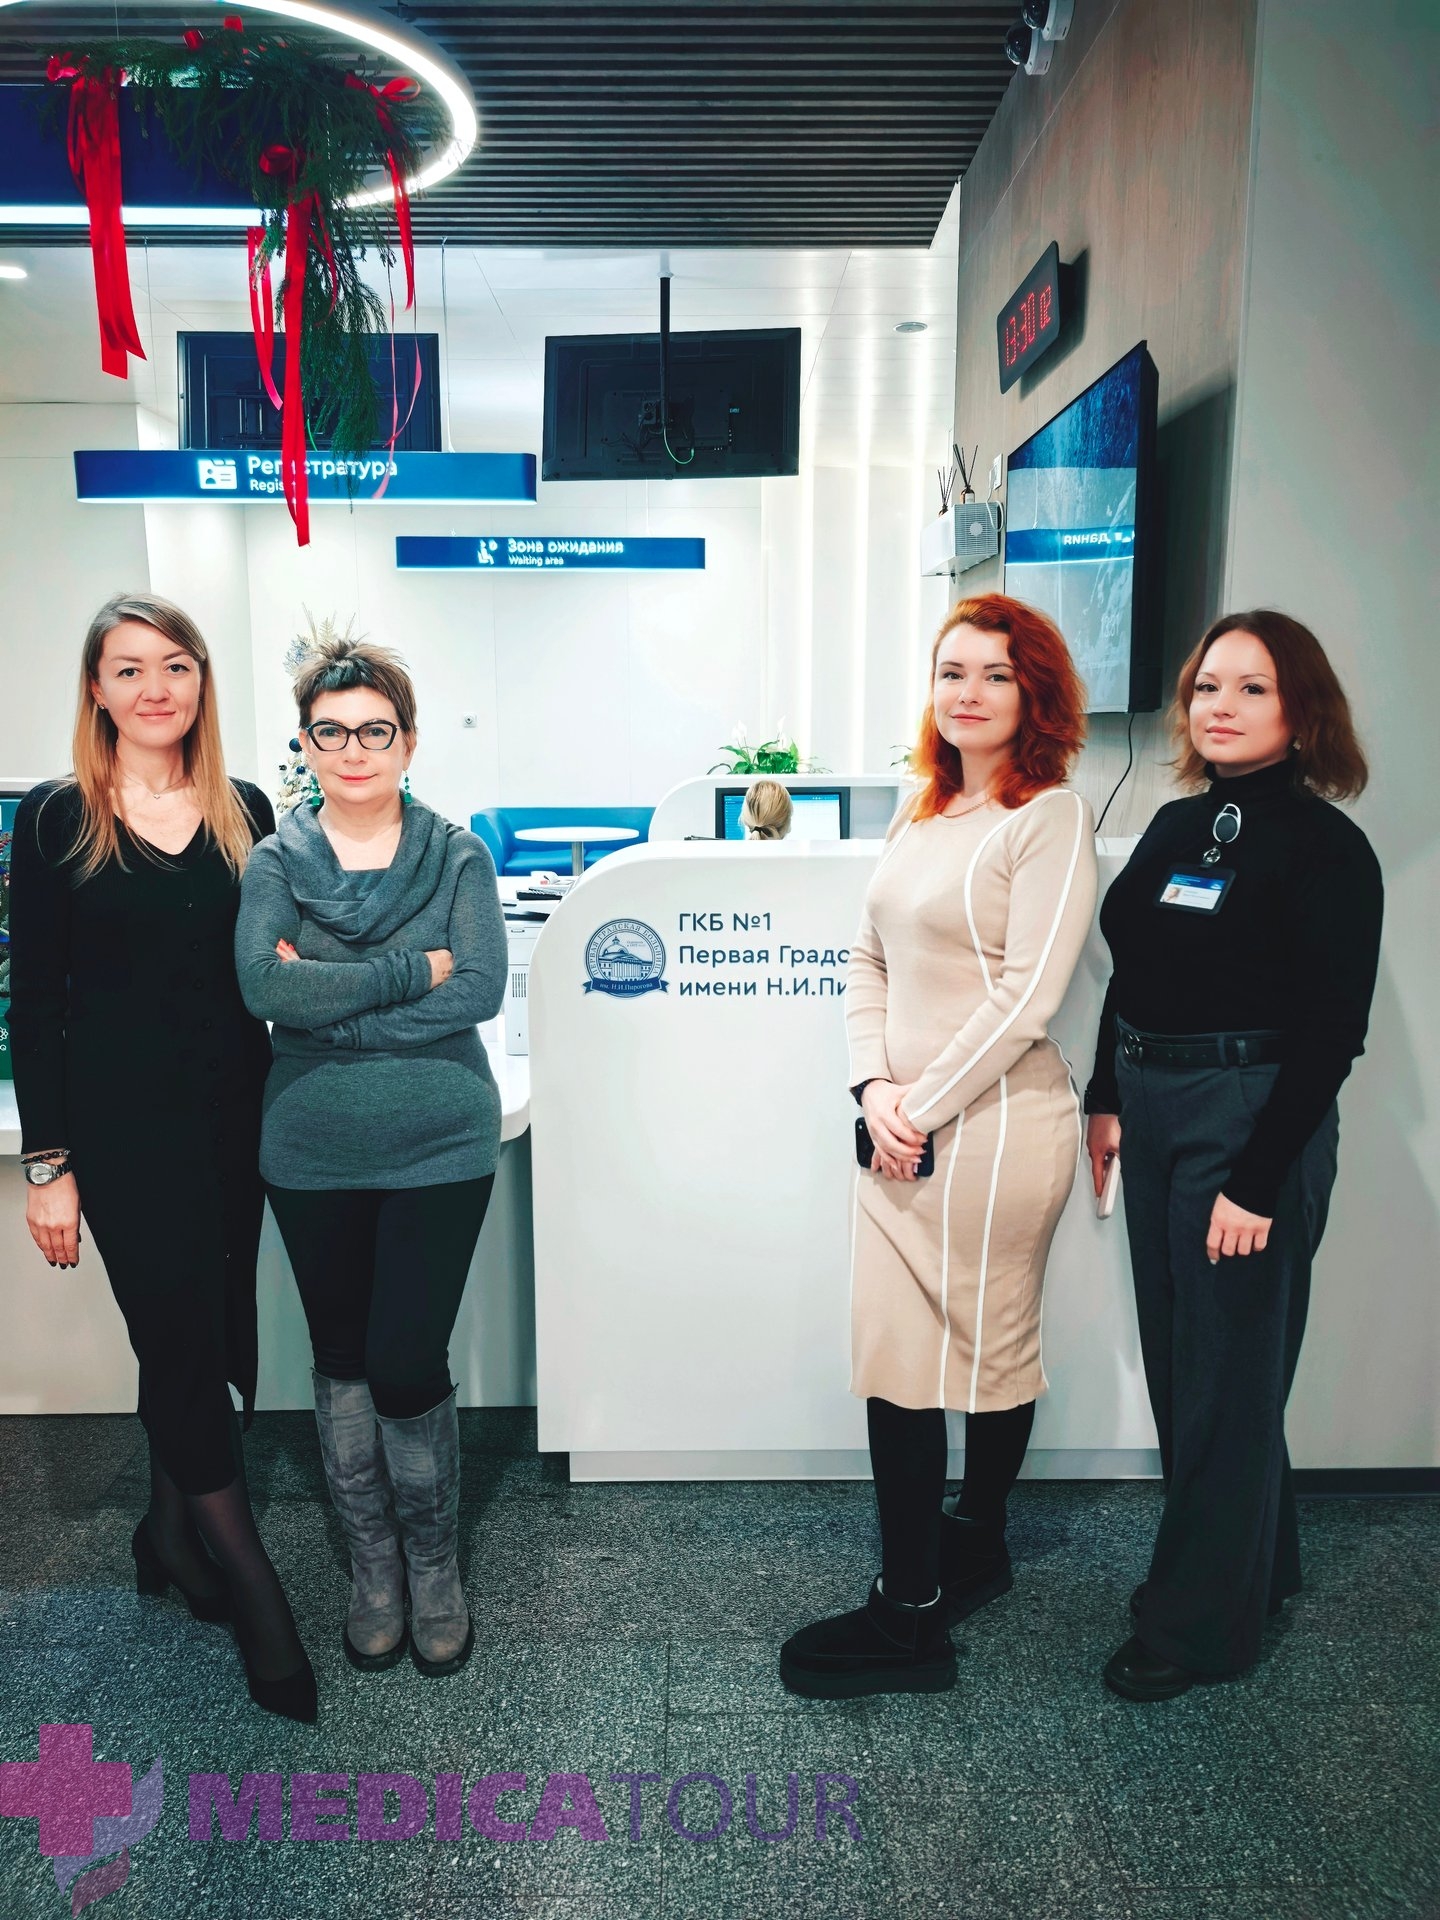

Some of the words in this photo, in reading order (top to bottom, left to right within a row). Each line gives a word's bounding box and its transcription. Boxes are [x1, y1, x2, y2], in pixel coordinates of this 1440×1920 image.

[1006, 291, 1036, 366] 13:30
[1040, 285, 1052, 329] 02
[248, 456, 398, 480] Регстратура
[250, 478, 296, 493] Regis
[508, 538, 544, 553] Зона
[547, 541, 625, 556] ожидания
[508, 554, 543, 566] Waiting
[545, 556, 565, 566] area
[679, 913, 724, 932] ГКБ
[733, 912, 771, 932] №1
[679, 945, 770, 968] Первая
[779, 945, 850, 968] Градс
[679, 981, 757, 996] имени
[767, 977, 847, 996] Н.И.Пи
